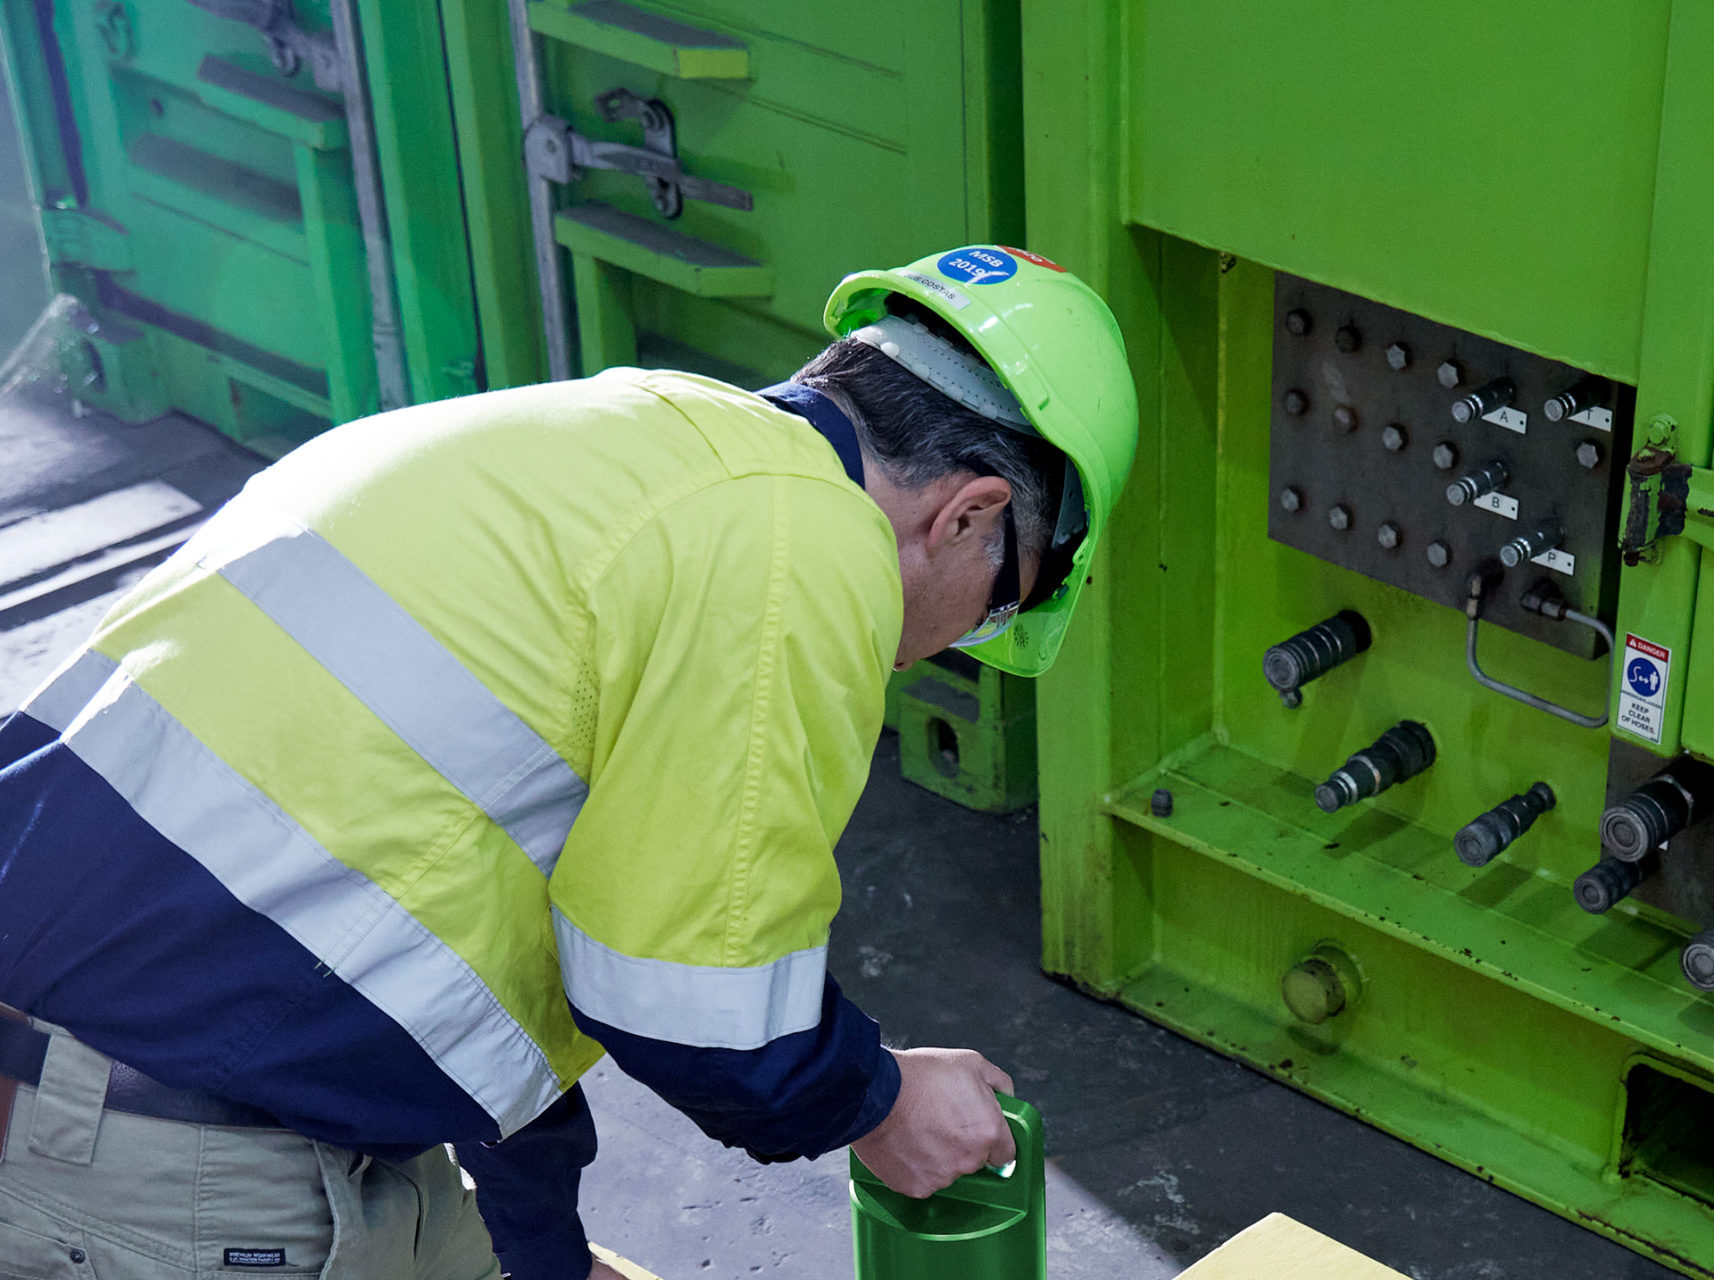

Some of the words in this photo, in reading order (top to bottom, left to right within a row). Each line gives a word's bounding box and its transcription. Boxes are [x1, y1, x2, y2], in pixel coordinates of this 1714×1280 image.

[969, 251, 1004, 268] MSB
[948, 258, 986, 277] 2019
[1499, 410, 1509, 424] A
[1585, 409, 1594, 421] T
[1491, 496, 1500, 509] B
[1547, 551, 1557, 564] P
[1638, 643, 1666, 659] DANGER
[1632, 702, 1649, 714] KEEP
[1628, 710, 1650, 723] CLEAR
